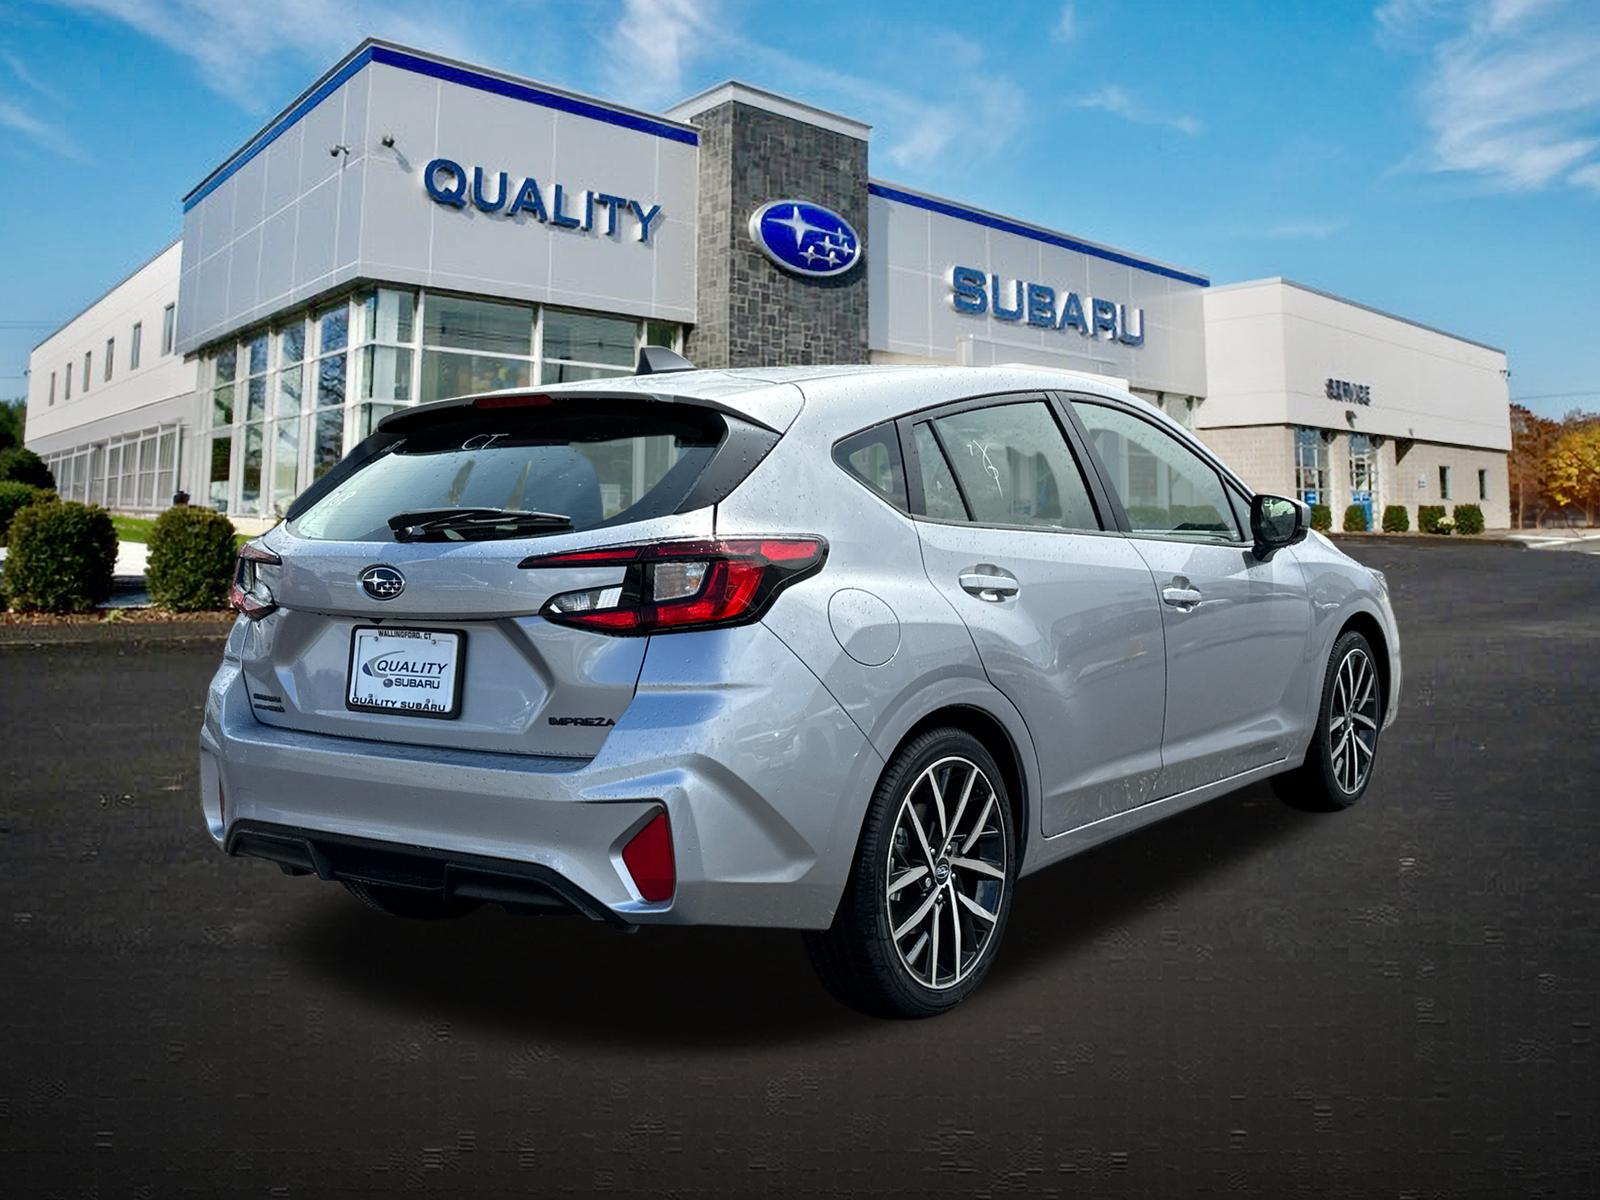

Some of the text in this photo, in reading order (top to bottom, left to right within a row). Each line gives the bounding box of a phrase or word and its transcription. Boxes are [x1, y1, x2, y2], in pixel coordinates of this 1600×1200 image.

[423, 158, 662, 243] QUALITY
[947, 265, 1145, 347] SUBARU
[1325, 378, 1371, 406] SERVICE
[423, 632, 432, 641] CT
[377, 660, 448, 674] QUALITY
[394, 678, 440, 689] SUBARU
[352, 697, 446, 711] QUALITY SUBARU
[548, 716, 616, 727] IMPREZA
